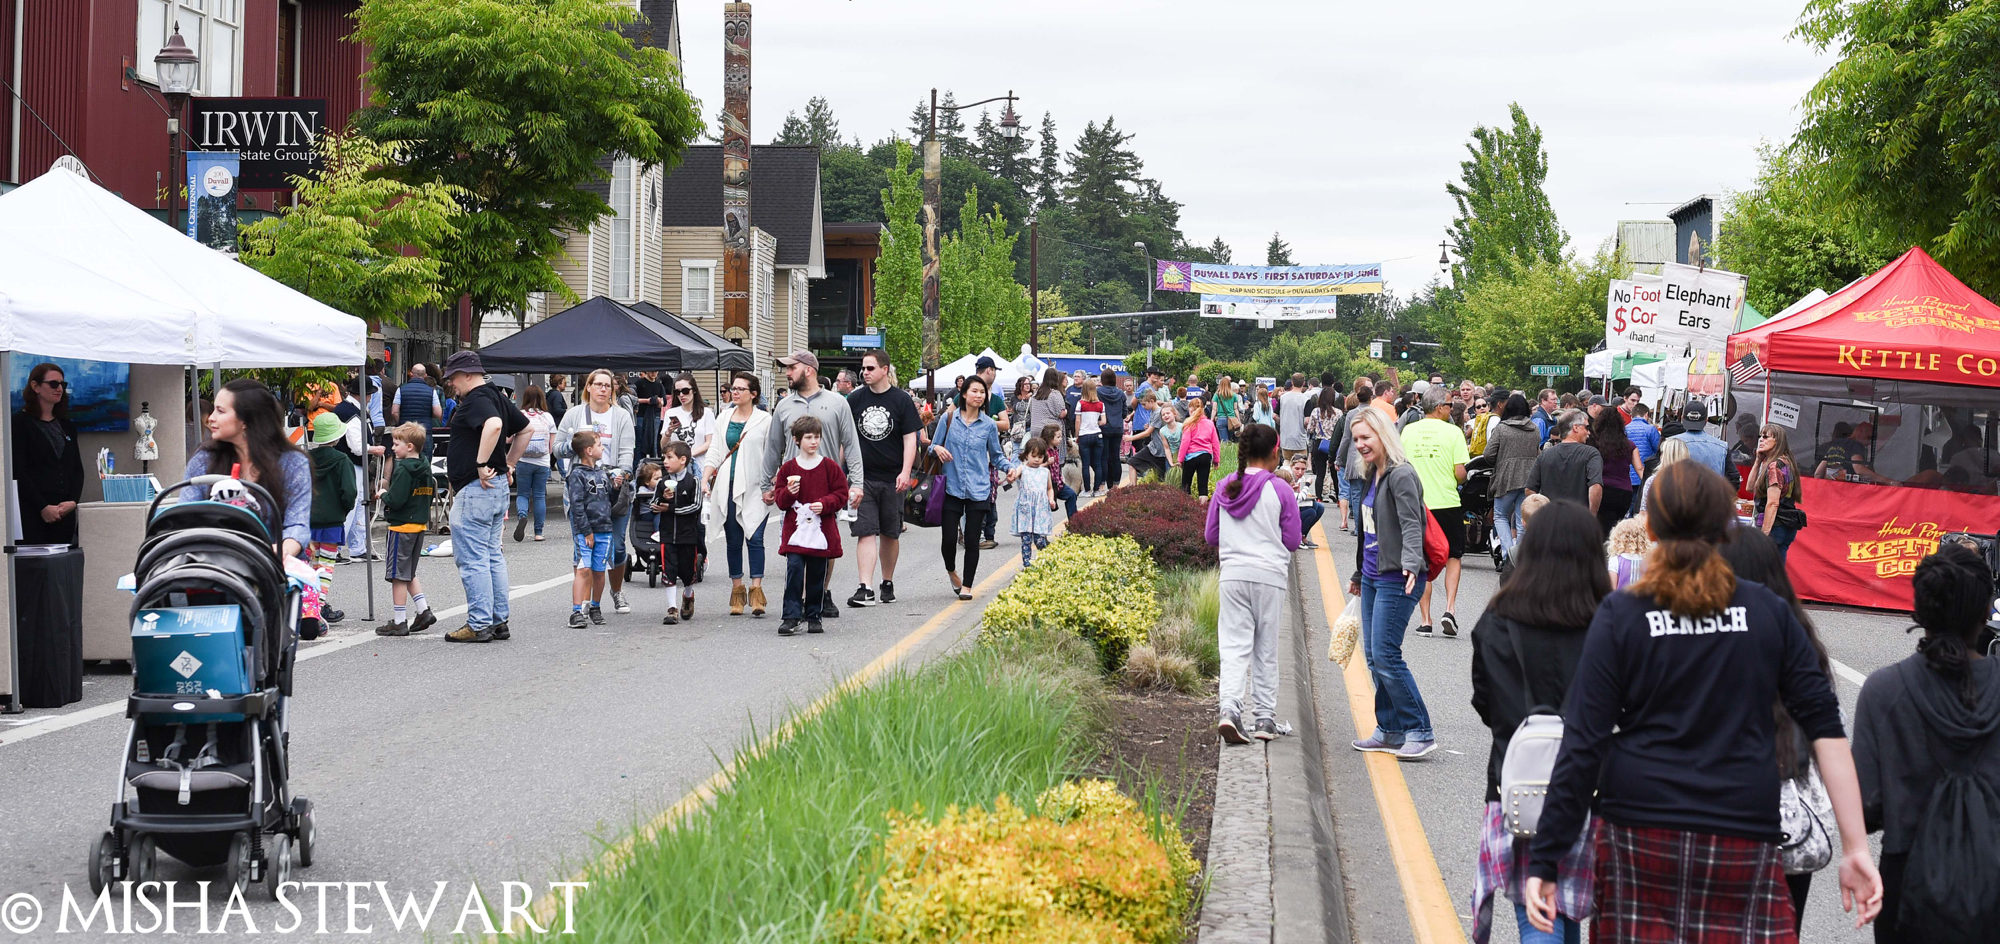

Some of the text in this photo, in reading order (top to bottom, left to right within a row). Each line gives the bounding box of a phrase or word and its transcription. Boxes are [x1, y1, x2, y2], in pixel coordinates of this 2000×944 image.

[201, 111, 319, 147] IRWIN
[233, 149, 318, 164] state Group
[1194, 270, 1230, 280] DUVALL
[1232, 271, 1258, 280] DAYS
[1264, 272, 1290, 281] FIRST
[1291, 271, 1342, 281] SATURDAY
[1343, 270, 1354, 279] IN
[1356, 268, 1380, 278] JUNE
[1665, 283, 1732, 310] Elephant
[1881, 295, 1971, 311] Hand Popped
[1678, 310, 1711, 330] Ears
[1852, 305, 2000, 331] KETTLE
[1884, 316, 1977, 335] CORN
[1838, 344, 1941, 371] KETTLE
[1532, 366, 1539, 374] NE
[1540, 366, 1560, 374] STELLA
[861, 405, 891, 419] KOLOA
[1877, 516, 1918, 538] Hand
[1645, 606, 1749, 638] BENISCH
[180, 656, 193, 673] PSE
